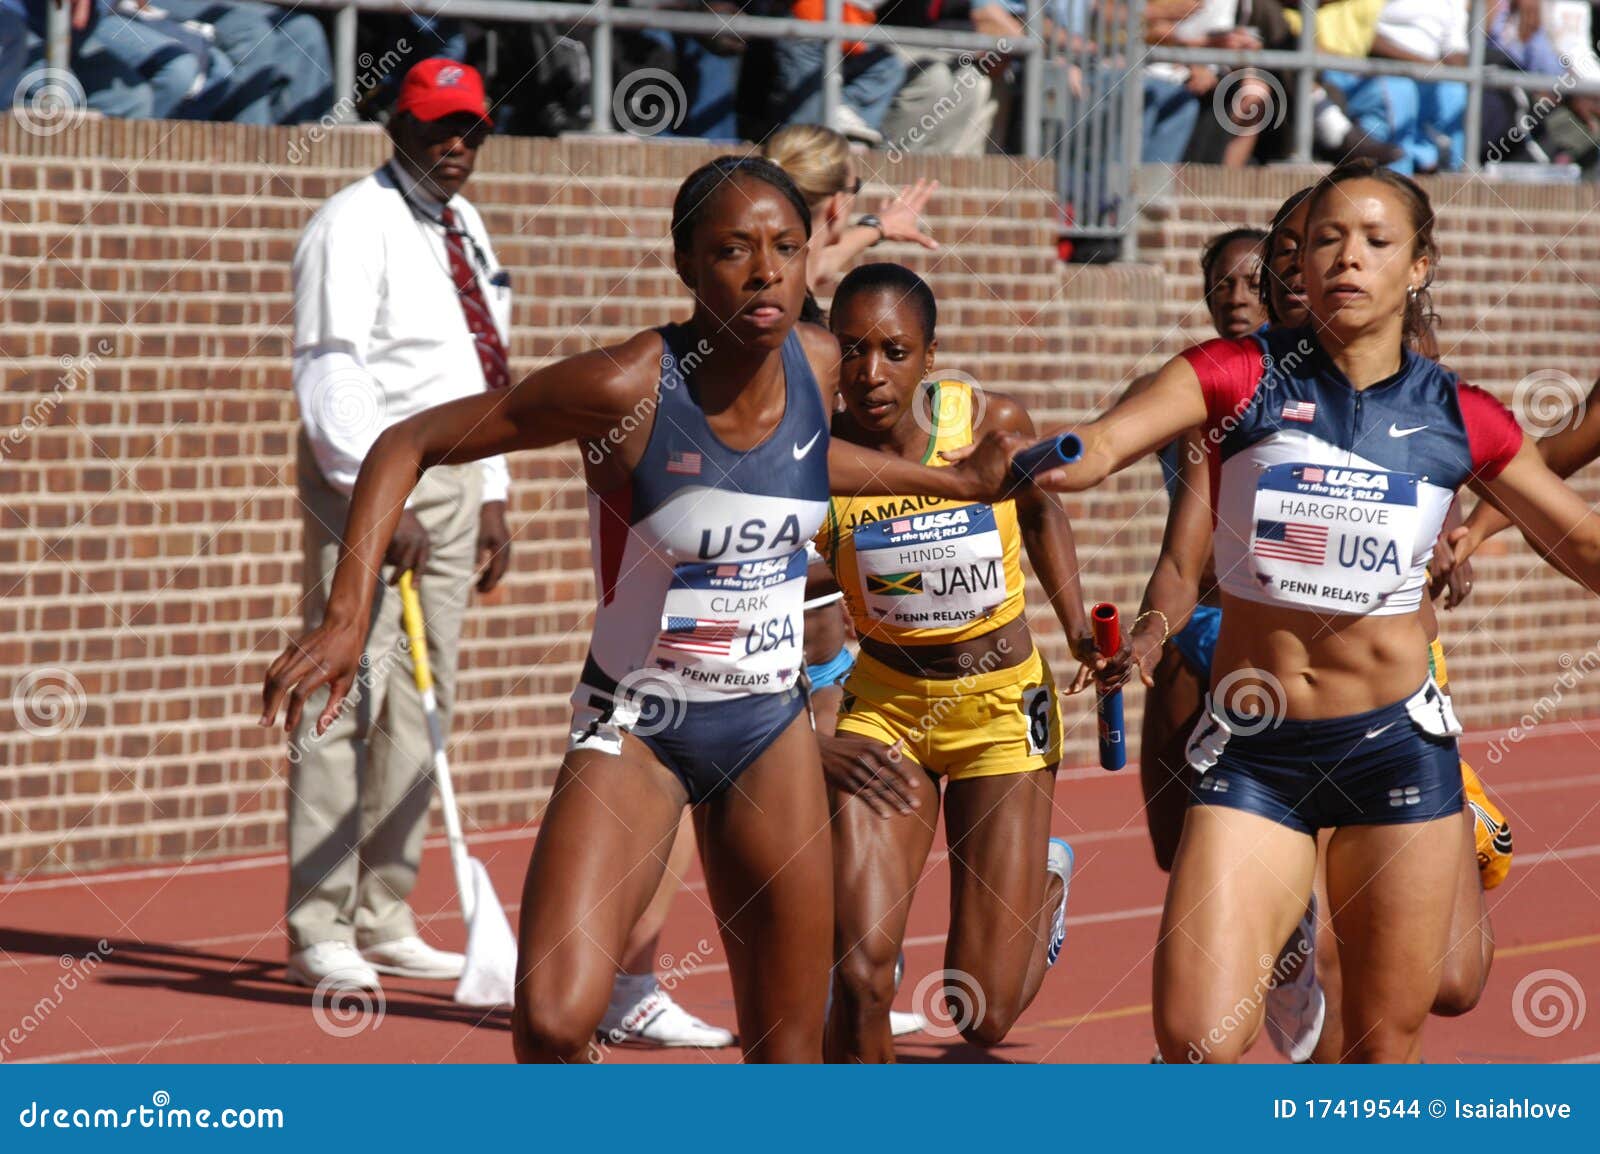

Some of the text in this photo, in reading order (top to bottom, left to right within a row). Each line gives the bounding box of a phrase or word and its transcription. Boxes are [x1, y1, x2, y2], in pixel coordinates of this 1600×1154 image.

[1297, 483, 1309, 491] vs
[1311, 483, 1328, 493] the
[1326, 469, 1389, 490] USA
[845, 495, 950, 529] JAMAIC
[912, 510, 970, 531] USA
[1280, 500, 1389, 525] HARGROVE
[699, 514, 801, 560] USA
[902, 532, 918, 542] the
[899, 545, 956, 564] HINDS
[1338, 533, 1401, 575] USA
[738, 557, 790, 579] USA
[933, 560, 998, 597] JAM
[723, 577, 742, 588] the
[1280, 579, 1370, 604] PENN RELAYS
[710, 595, 769, 613] CLARK
[895, 610, 976, 623] PENN RELAYS
[745, 614, 795, 656] USA
[681, 667, 770, 685] PENN RELAYS
[1029, 689, 1049, 749] 6
